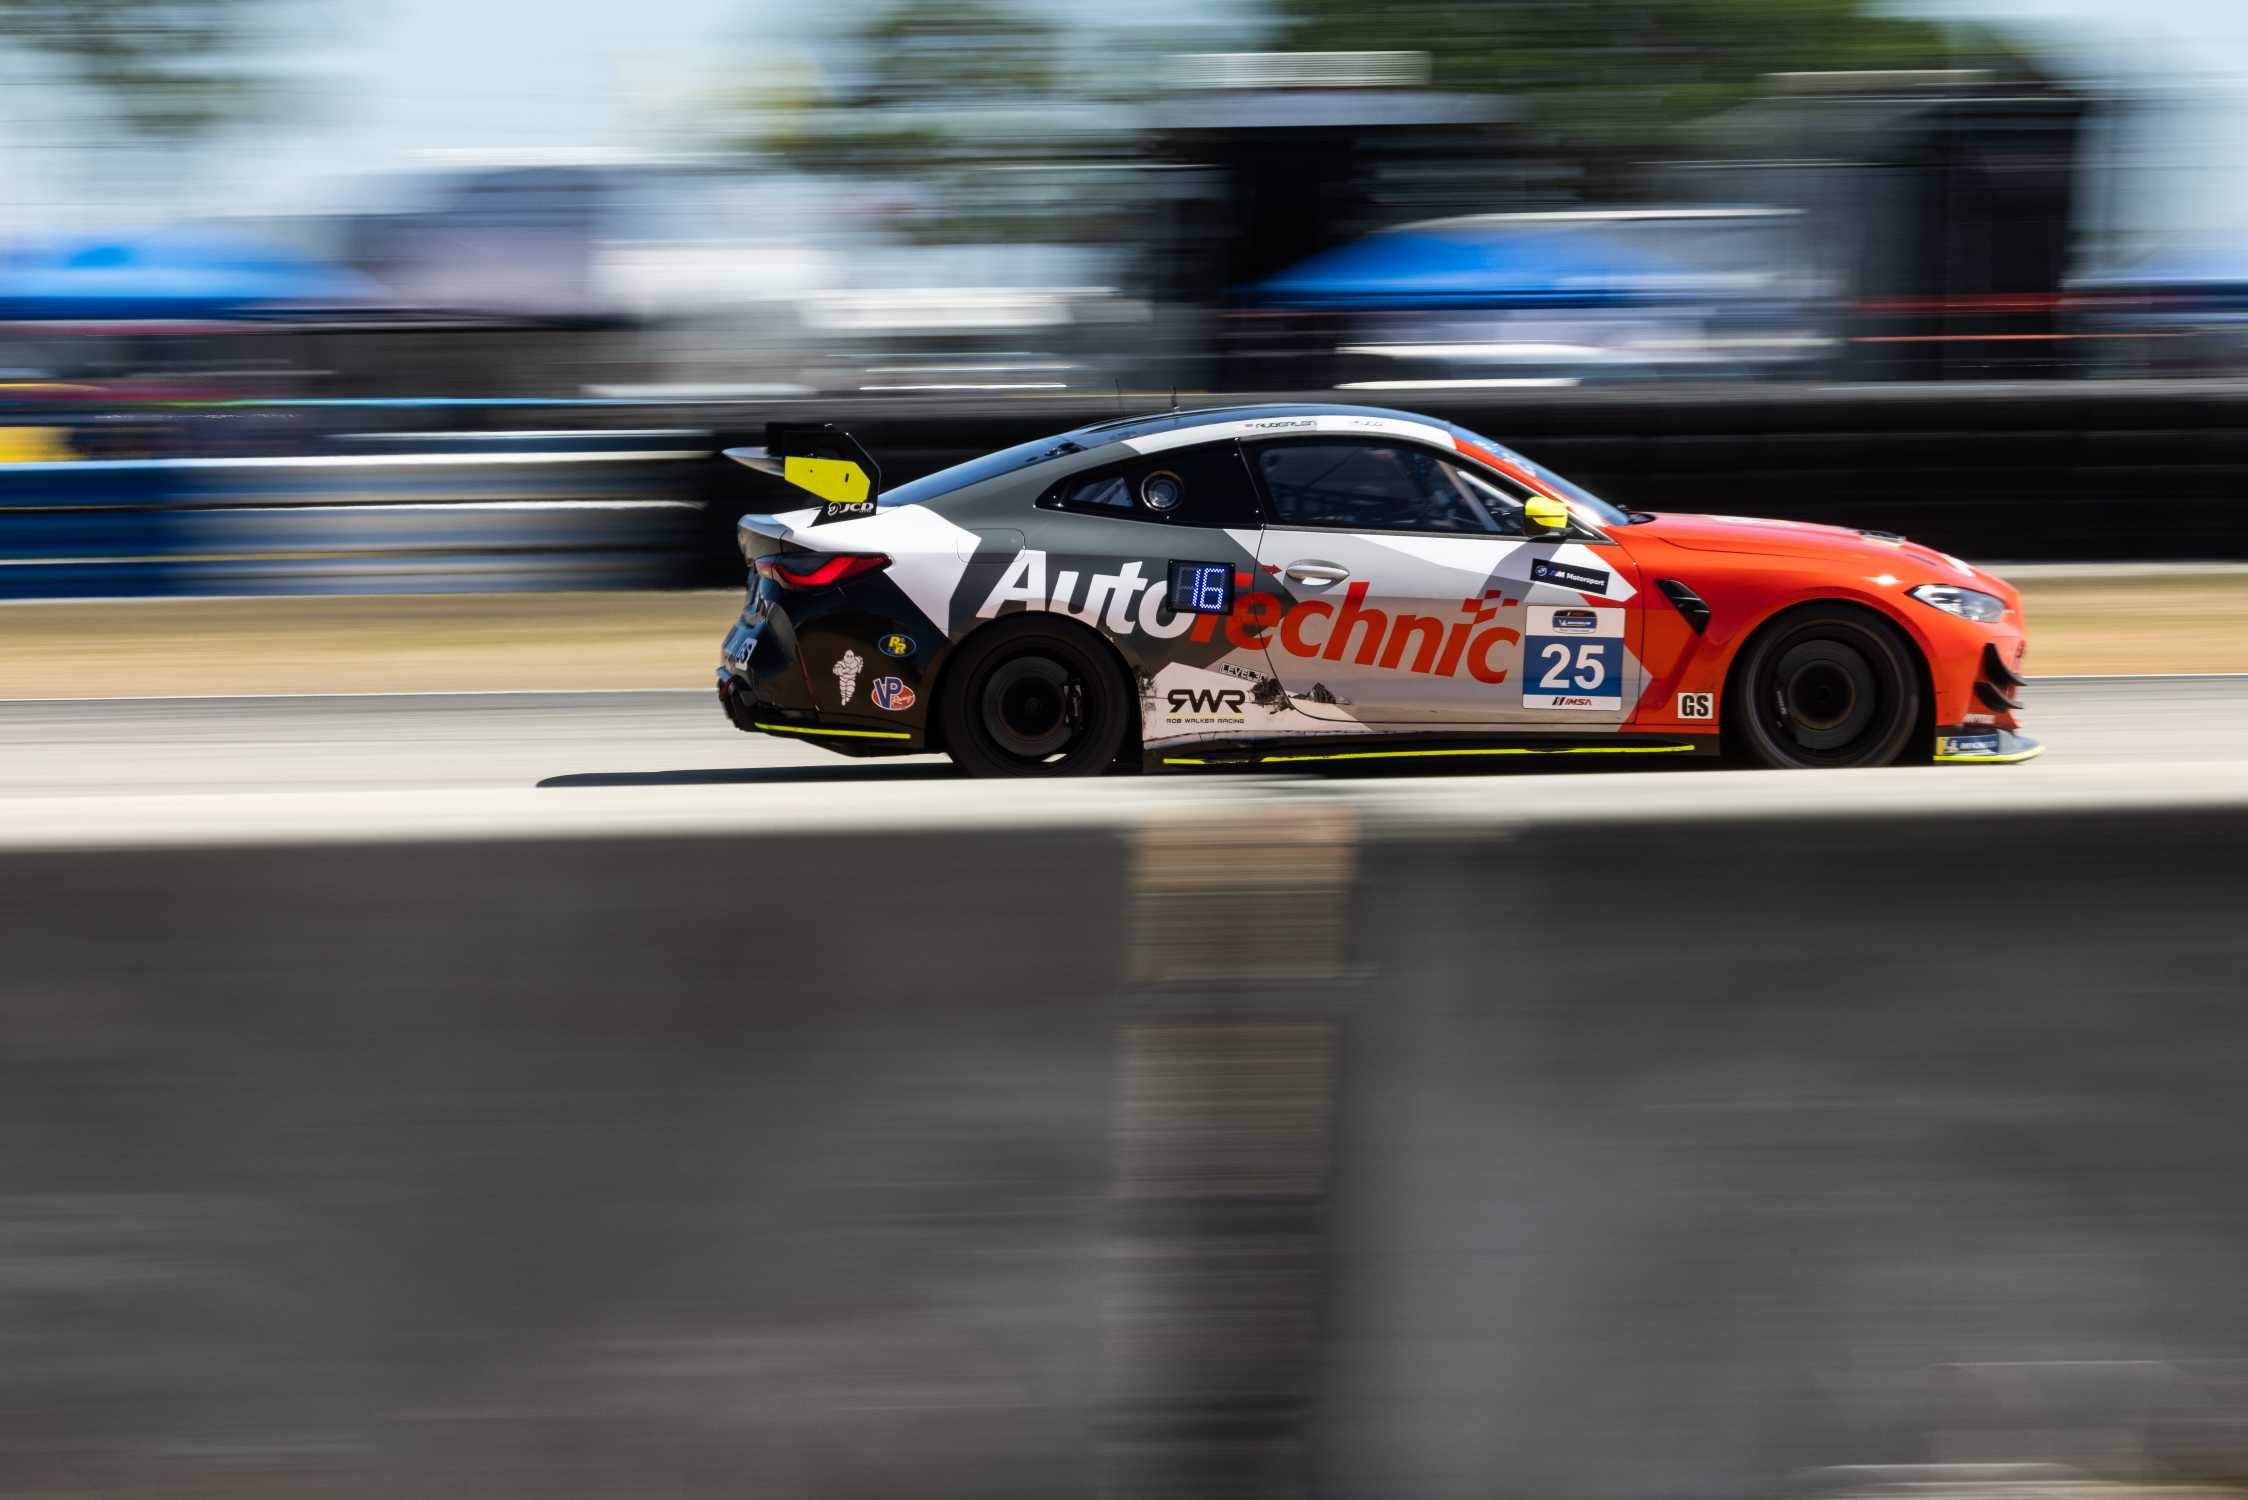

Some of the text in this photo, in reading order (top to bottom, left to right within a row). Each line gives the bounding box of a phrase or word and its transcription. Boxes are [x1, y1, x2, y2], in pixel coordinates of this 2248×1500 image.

[838, 503, 874, 514] JCD
[1566, 573, 1605, 587] Motorsport
[1539, 643, 1605, 690] 25
[873, 676, 904, 710] VP
[1564, 698, 1592, 706] IMSA
[1682, 695, 1709, 717] GS
